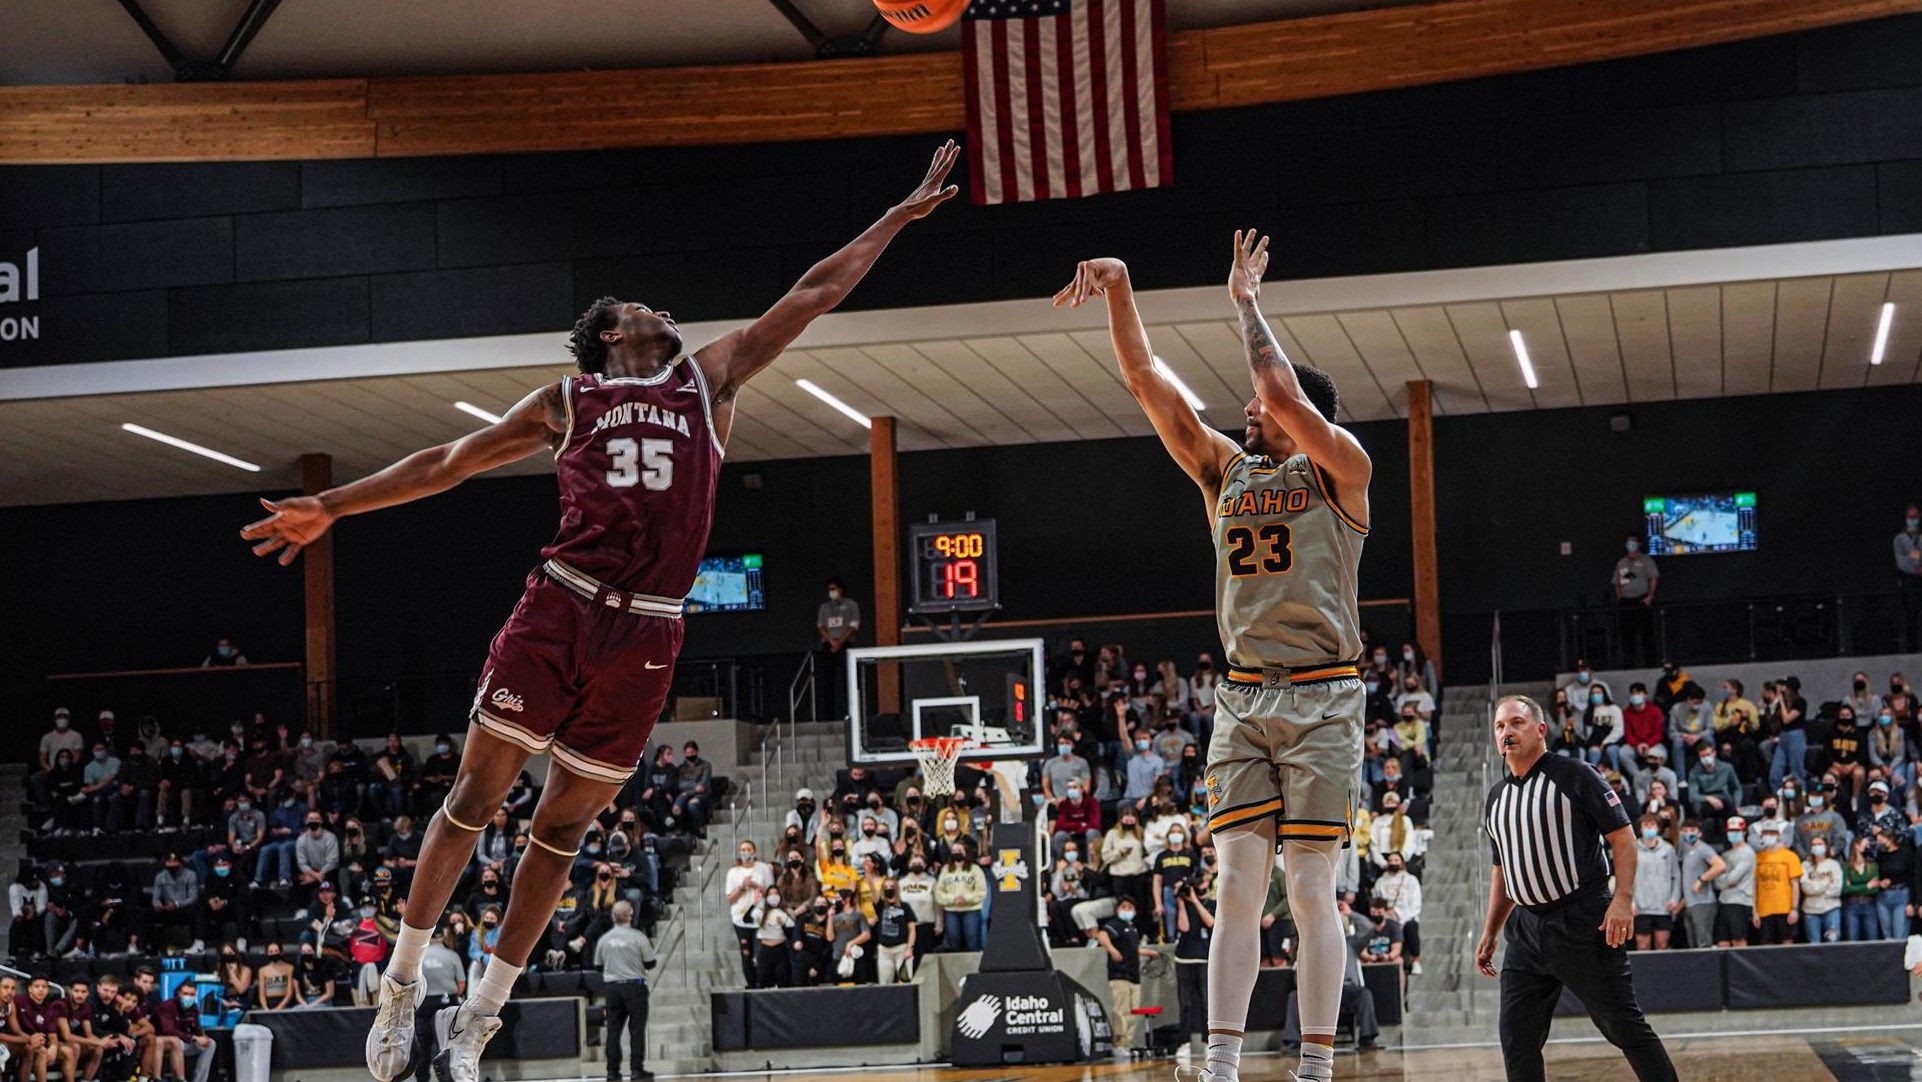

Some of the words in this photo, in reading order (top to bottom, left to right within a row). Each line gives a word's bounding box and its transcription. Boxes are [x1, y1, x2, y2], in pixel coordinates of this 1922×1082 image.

[590, 401, 691, 438] MONTANA
[605, 437, 674, 492] 35
[1219, 487, 1310, 518] DAHO
[935, 533, 983, 558] 9:00
[1224, 522, 1294, 578] 23
[945, 560, 978, 599] 19
[1005, 996, 1048, 1010] Idaho
[1005, 1009, 1063, 1024] Central
[1005, 1026, 1036, 1035] CREDIT
[1038, 1025, 1064, 1034] UNION
